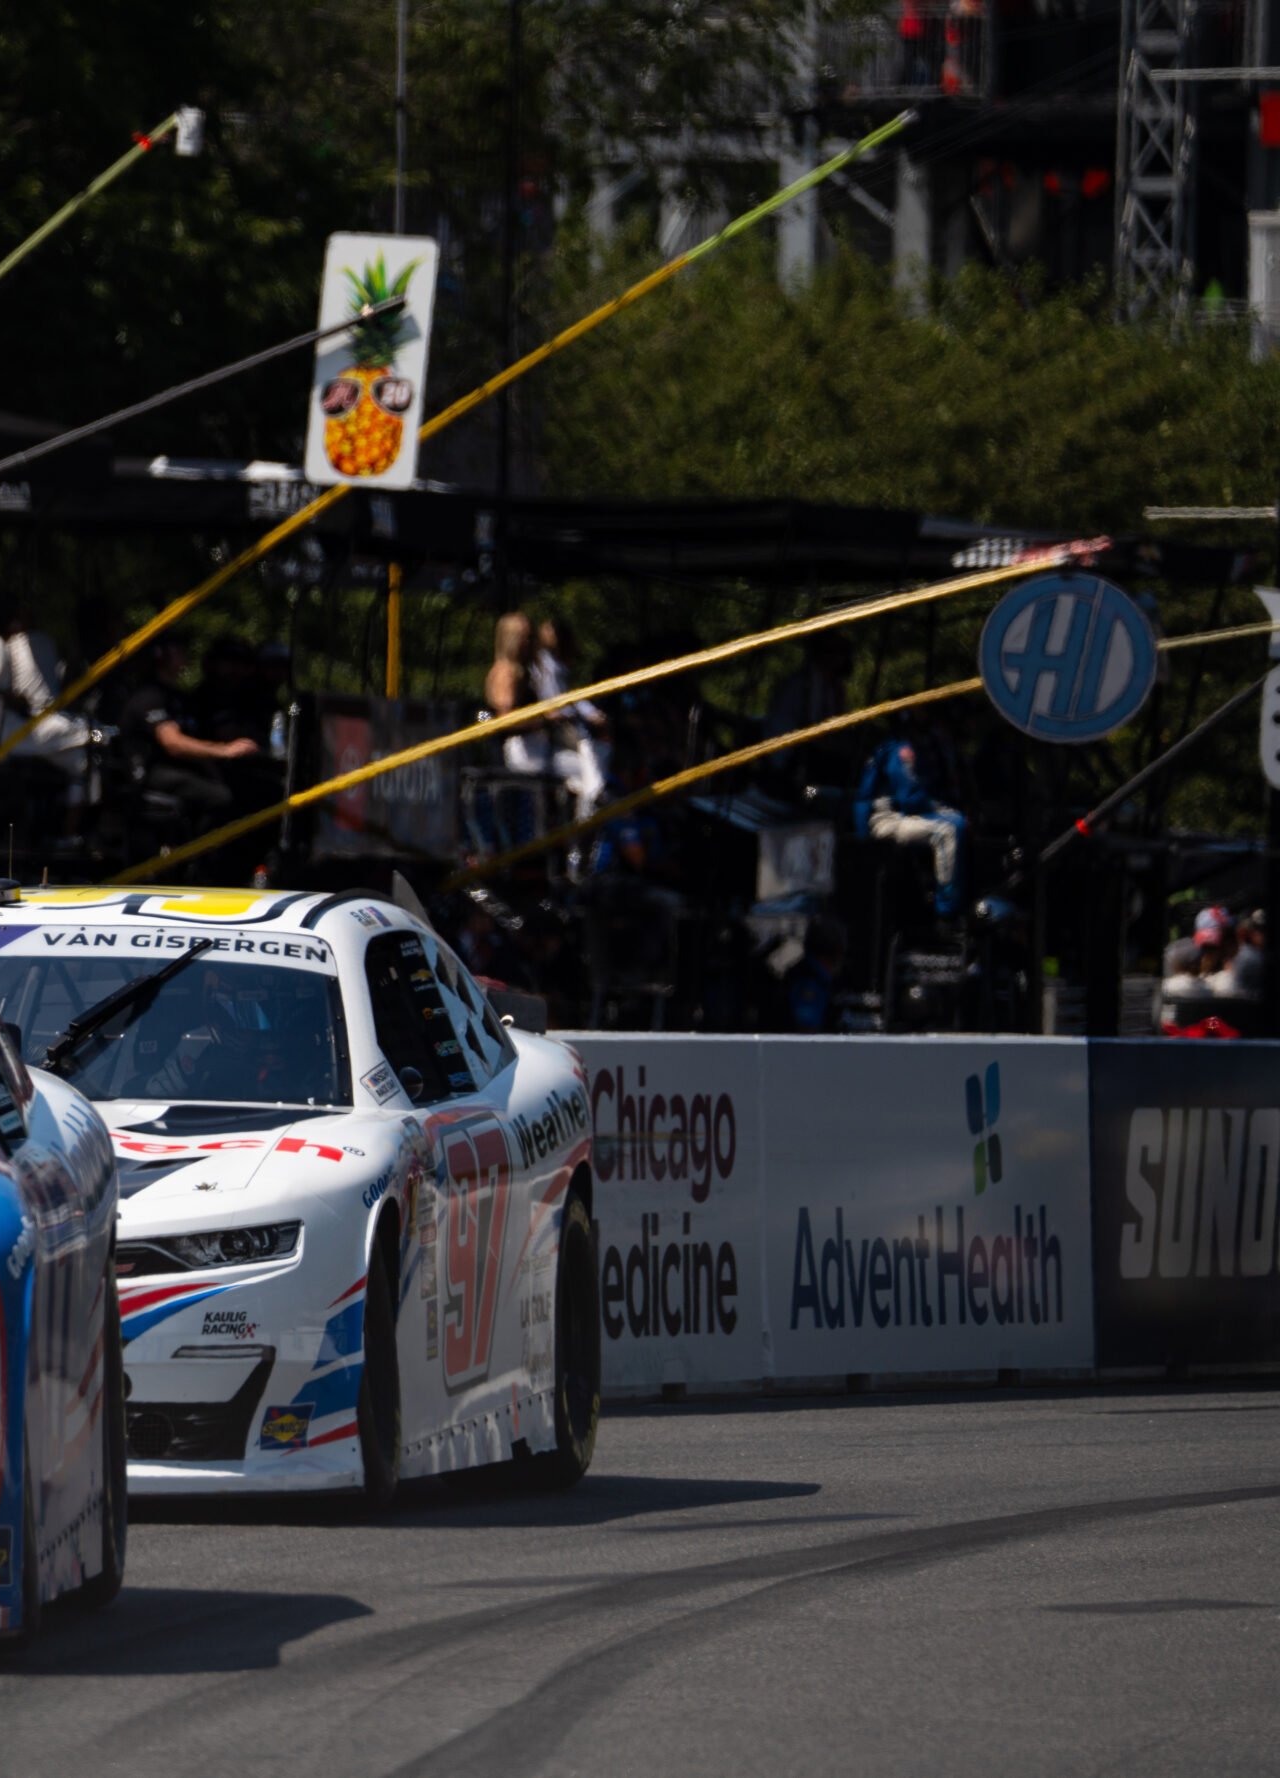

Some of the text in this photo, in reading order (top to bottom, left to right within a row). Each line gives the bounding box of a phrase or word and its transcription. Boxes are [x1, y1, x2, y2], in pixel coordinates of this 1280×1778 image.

[43, 932, 118, 948] VAN
[443, 1122, 512, 1385] 97
[592, 1211, 738, 1340] edicine
[790, 1205, 1063, 1331] AdventHealth
[202, 1323, 246, 1335] RACING
[204, 1311, 248, 1323] KAULIG
